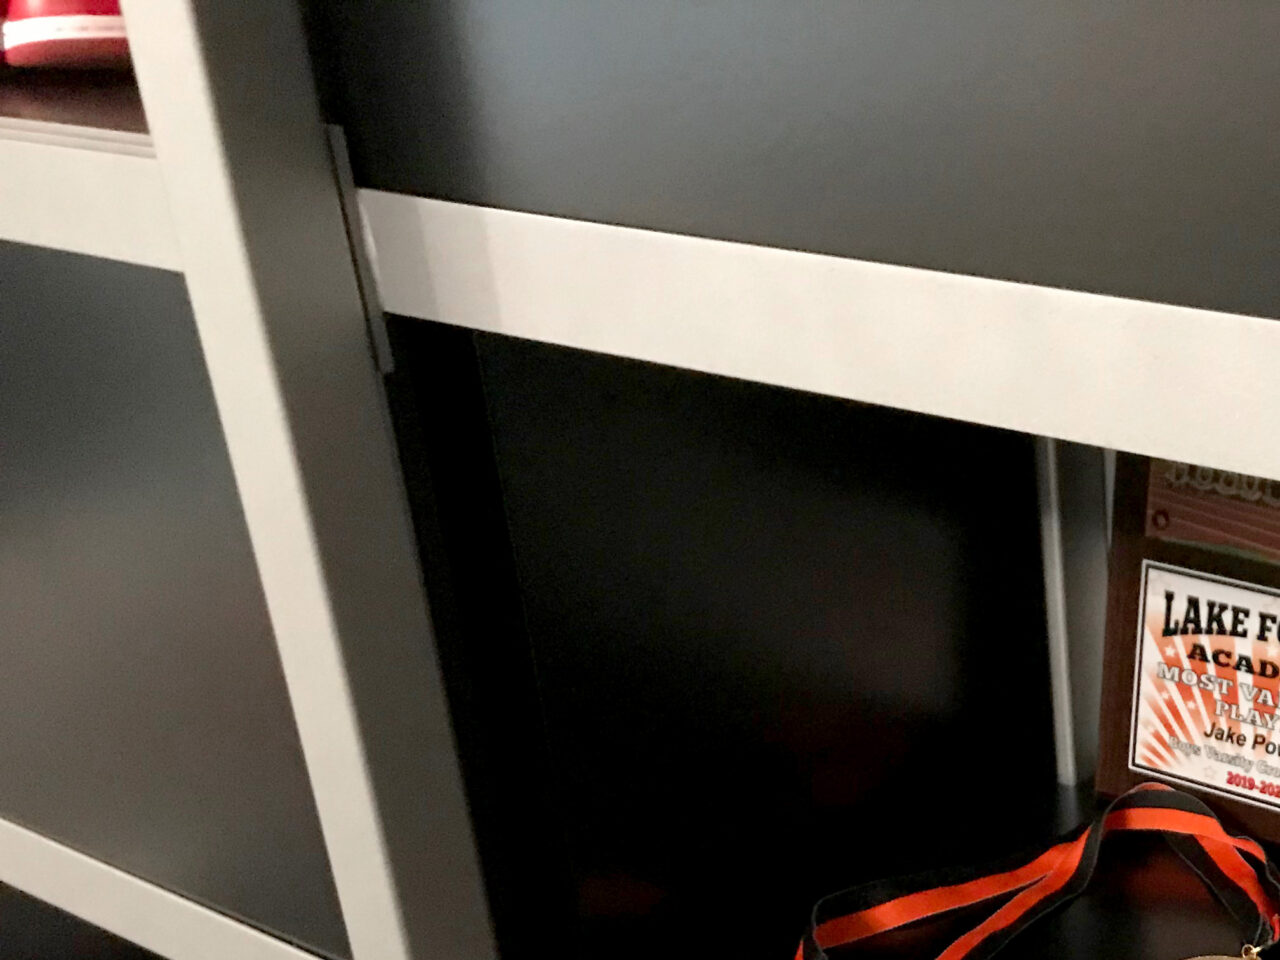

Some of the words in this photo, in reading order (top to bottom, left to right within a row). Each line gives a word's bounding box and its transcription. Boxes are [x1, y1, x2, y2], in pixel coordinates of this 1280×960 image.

[1162, 590, 1250, 638] LAKE
[1157, 661, 1234, 696] MOST
[1204, 722, 1247, 748] Jake
[1204, 744, 1257, 773] Varsity
